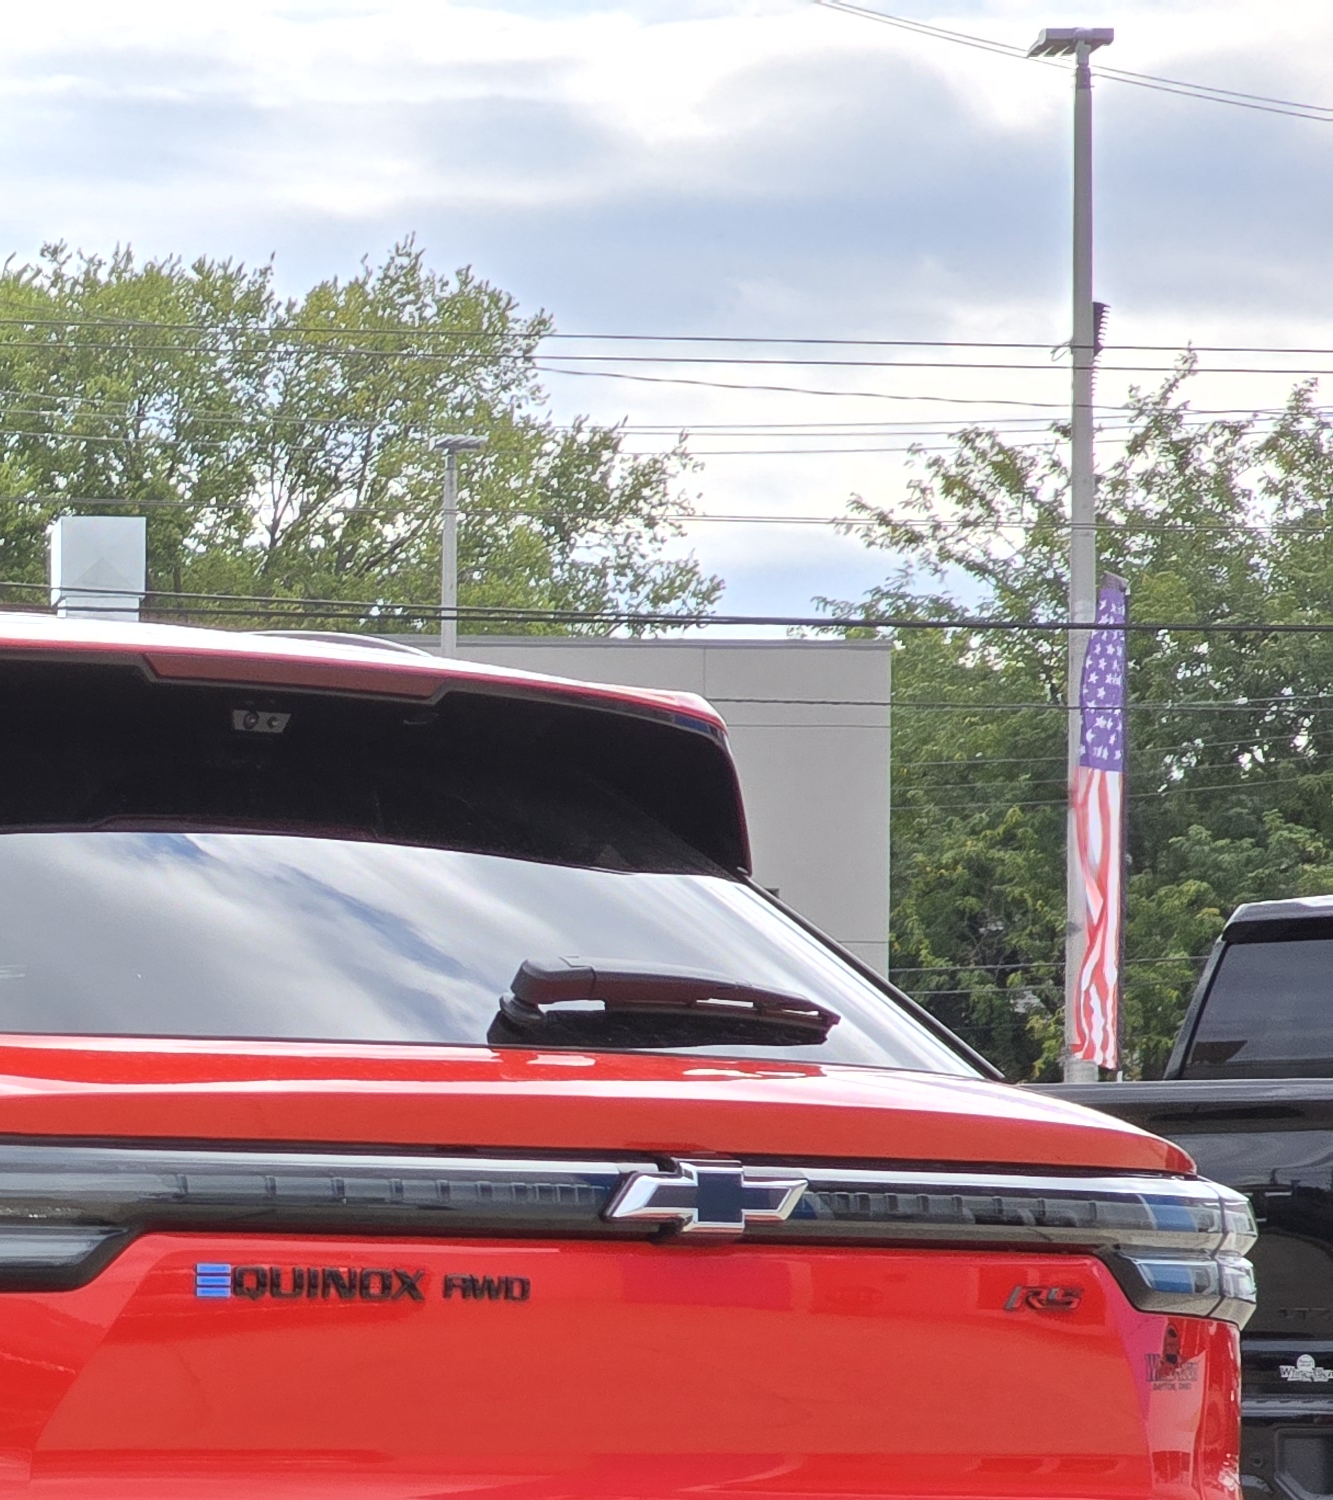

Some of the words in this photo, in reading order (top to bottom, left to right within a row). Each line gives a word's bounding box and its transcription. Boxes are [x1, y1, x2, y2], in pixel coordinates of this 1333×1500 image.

[195, 1263, 425, 1301] EQUINOX
[442, 1273, 531, 1301] AWD
[1003, 1286, 1085, 1312] RS
